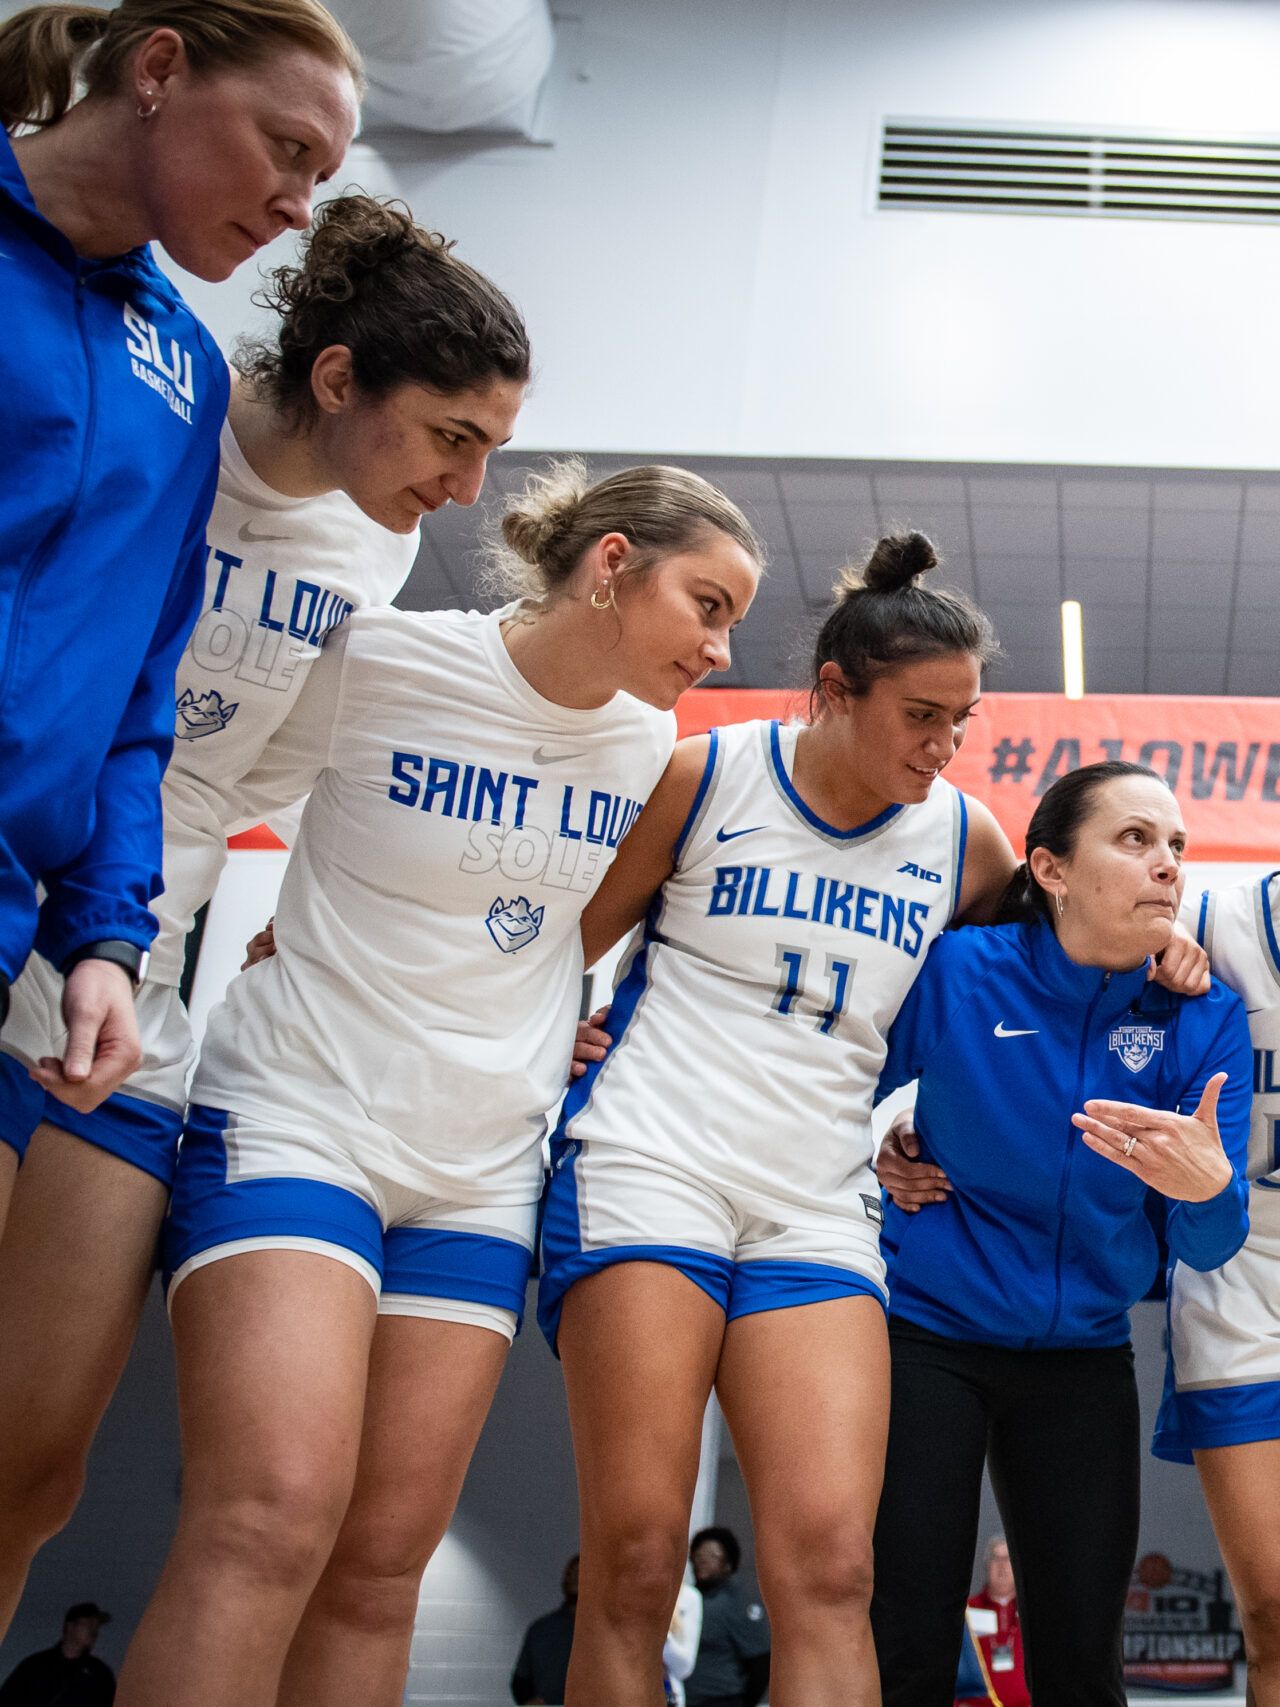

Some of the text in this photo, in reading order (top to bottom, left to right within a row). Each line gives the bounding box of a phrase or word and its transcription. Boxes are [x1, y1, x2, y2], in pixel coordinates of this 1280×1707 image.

[123, 301, 194, 404] SLU
[131, 357, 192, 424] BASKETBALL
[188, 608, 304, 692] OLE
[388, 752, 539, 830] SAINT
[459, 819, 605, 893] SOLE
[896, 861, 942, 884] A10
[705, 866, 933, 960] BILLIKENS
[763, 943, 858, 1039] 11
[1112, 1033, 1160, 1047] BILLIKENS
